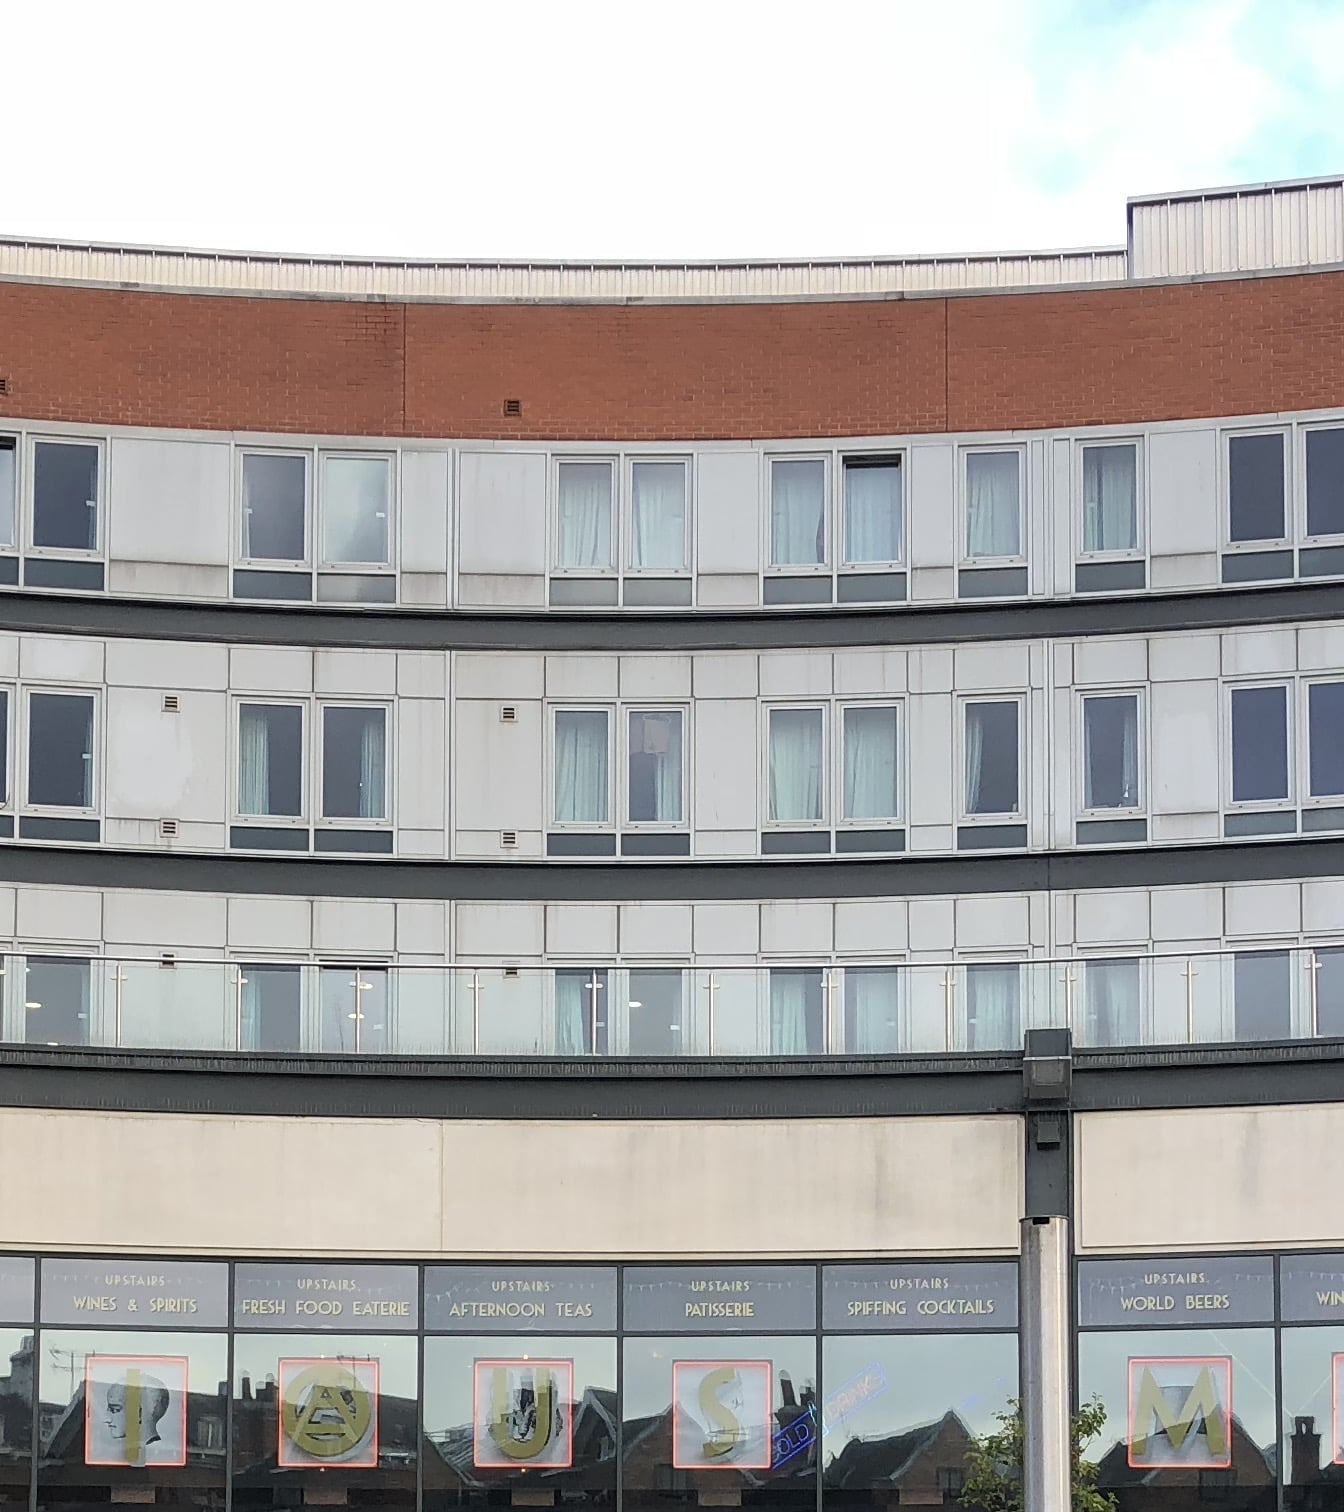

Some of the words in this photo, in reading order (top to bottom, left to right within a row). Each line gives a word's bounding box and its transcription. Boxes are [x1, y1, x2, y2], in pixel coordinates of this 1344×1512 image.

[105, 1275, 165, 1287] UPSTAIRS
[297, 1279, 357, 1291] UPSTAIRS
[890, 1278, 950, 1290] UPSTAIRS
[1144, 1272, 1206, 1285] UPSTAIRS
[492, 1280, 551, 1293] UPSTAIRS
[691, 1280, 751, 1292] UPSTAIRS
[73, 1296, 117, 1311] WINES
[127, 1299, 138, 1312] &
[149, 1299, 198, 1314] SPIRITS
[242, 1300, 286, 1315] FRESH
[295, 1300, 343, 1316] FOOD
[352, 1301, 410, 1317] EATERIE
[847, 1300, 907, 1316] SPIFFING
[917, 1299, 995, 1315] COCKTAILS
[1120, 1295, 1175, 1311] WORLD
[1185, 1294, 1231, 1310] BEERS
[448, 1302, 546, 1318] AFTERNOON
[556, 1302, 593, 1318] TEAS
[685, 1302, 755, 1318] PATISSERIE
